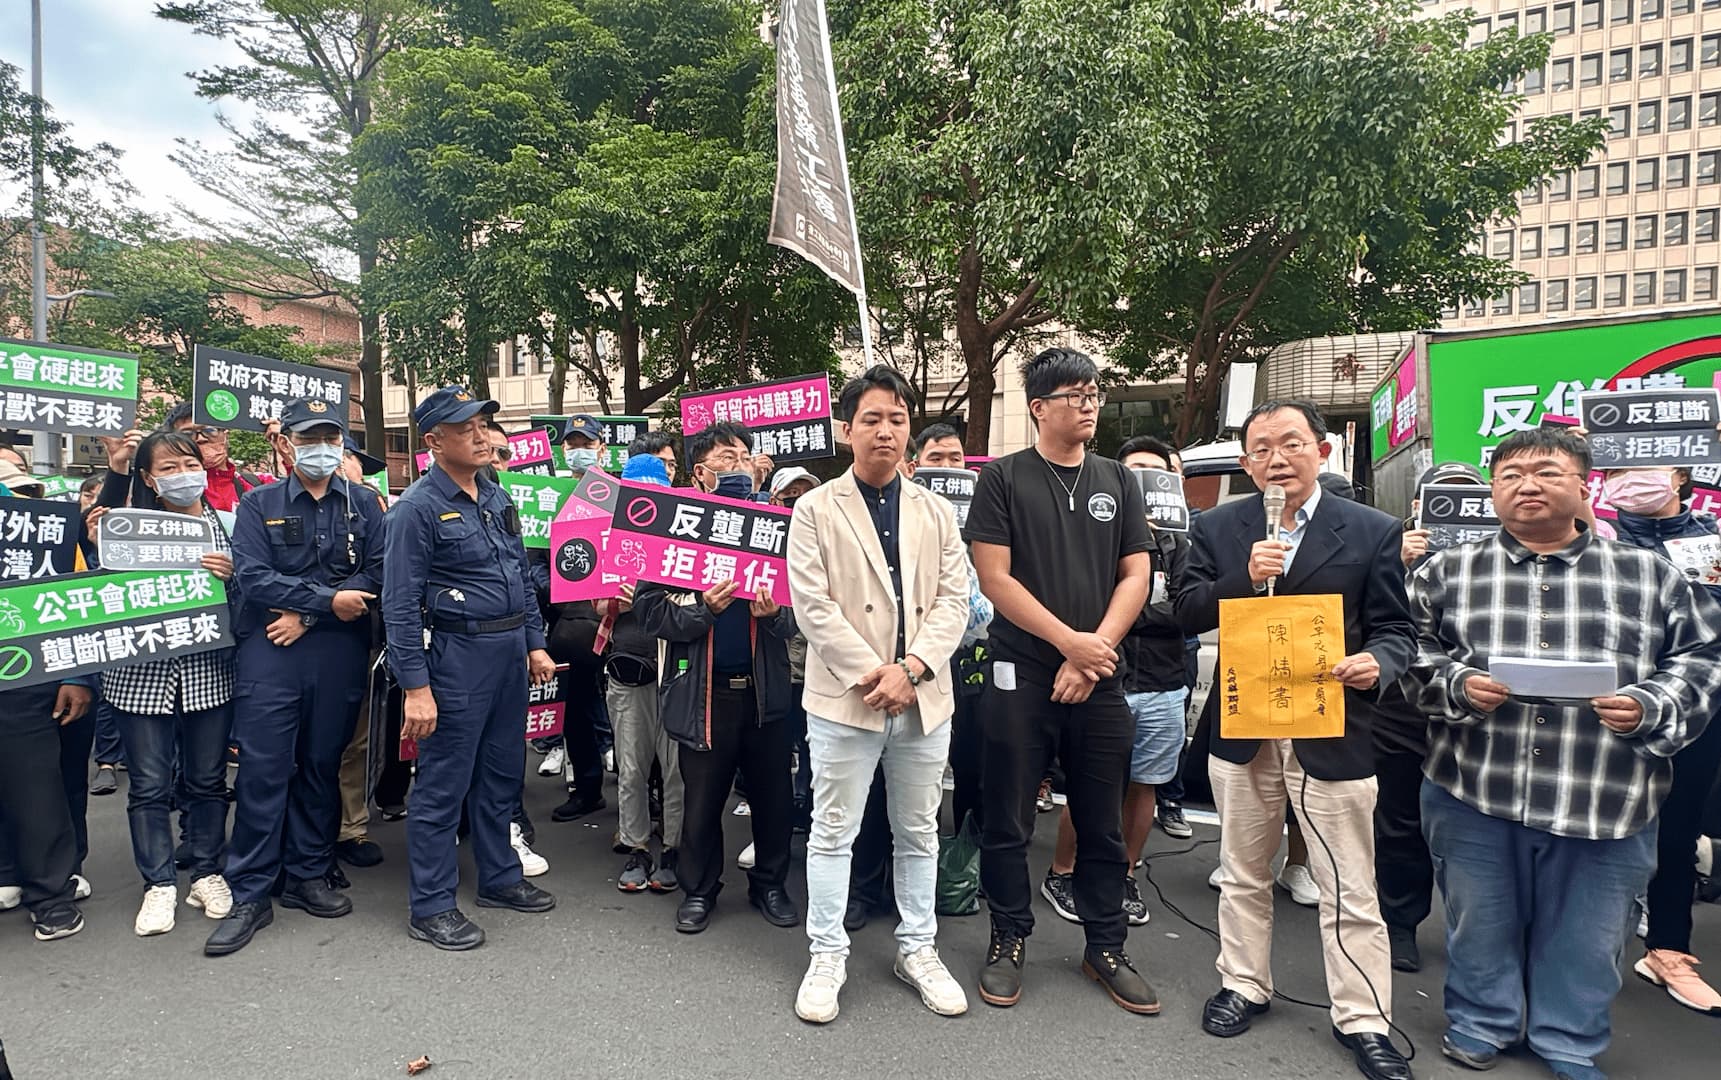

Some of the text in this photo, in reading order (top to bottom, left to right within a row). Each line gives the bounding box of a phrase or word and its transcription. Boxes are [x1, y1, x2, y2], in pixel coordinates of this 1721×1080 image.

[0, 351, 125, 392] 會硬起來
[209, 359, 342, 404] 政府不要幫外商
[0, 390, 123, 431] 獸不要來
[712, 386, 822, 424] 保留市場競爭力
[1626, 400, 1711, 425] 反壟斷
[1625, 434, 1711, 459] 拒獨佔
[500, 484, 561, 512] 平會
[930, 477, 975, 497] 反併購
[137, 519, 204, 538] 反併購
[668, 503, 786, 554] 反壟斷
[138, 544, 203, 563] 要競爭
[660, 543, 778, 594] 拒獨佔
[33, 572, 214, 625] 公平會硬起來
[40, 613, 222, 673] 壟斷獸不要來
[1267, 624, 1293, 709] 陳情書
